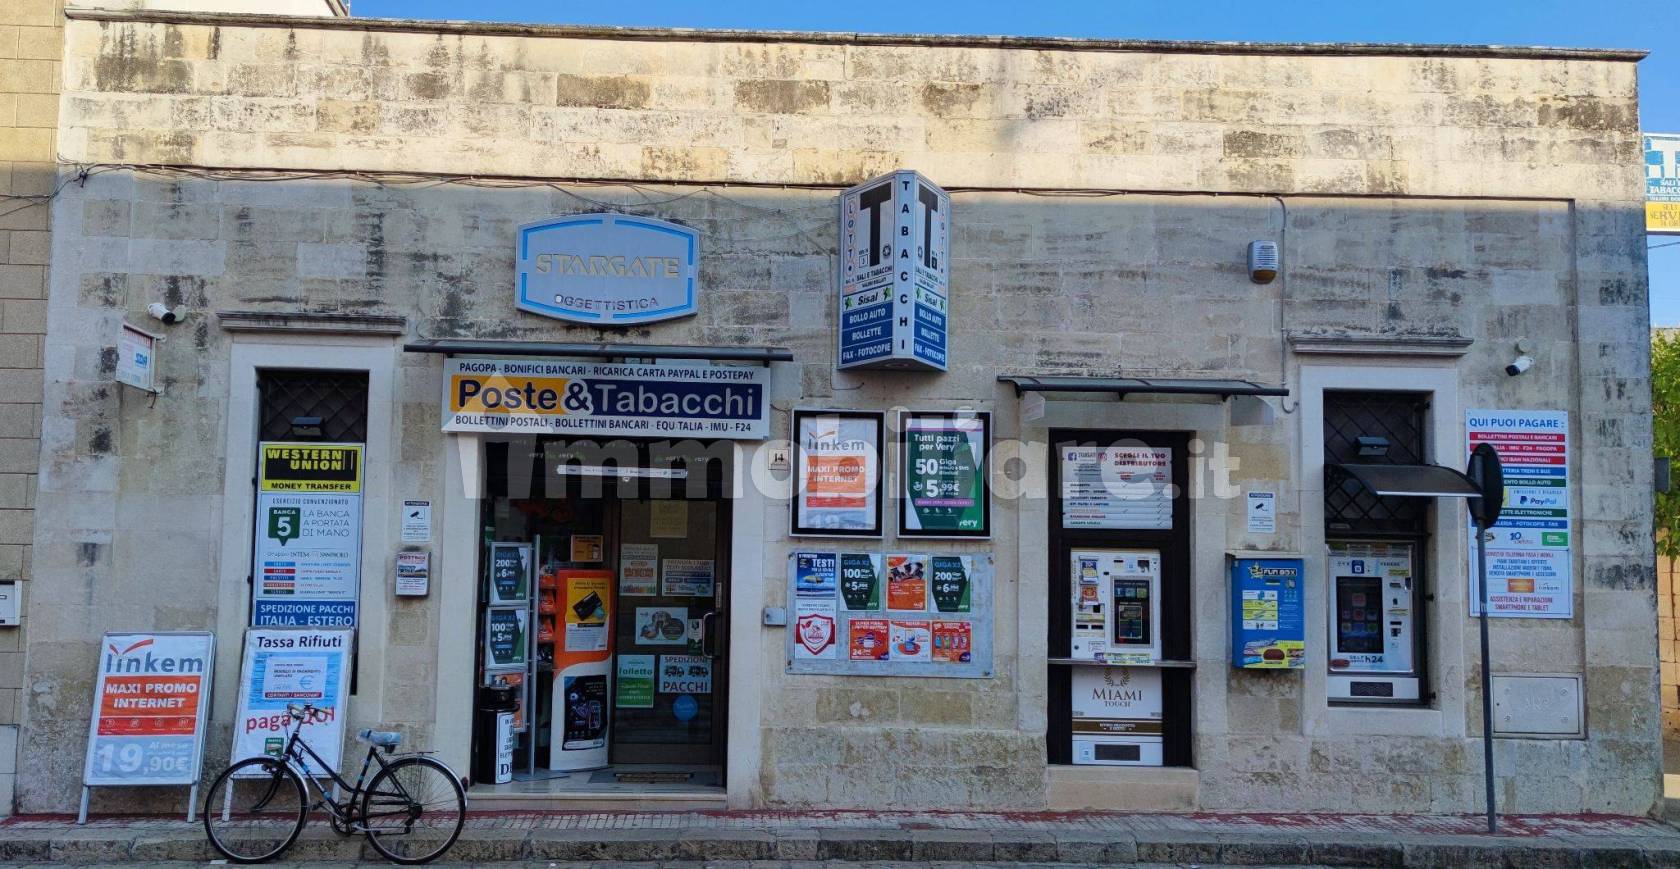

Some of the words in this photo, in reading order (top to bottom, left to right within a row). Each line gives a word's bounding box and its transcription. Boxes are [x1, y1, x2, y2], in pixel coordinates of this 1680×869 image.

[535, 254, 680, 279] STARGATE
[900, 181, 910, 350] TABACCHI
[554, 294, 660, 312] OGGETTISTICA
[858, 292, 878, 306] Sisal
[870, 308, 886, 319] AUTO
[843, 350, 854, 360] FAX
[858, 342, 891, 357] FOTOCOPIE
[459, 362, 497, 373] PAGOPA
[504, 364, 545, 374] BONIFICI
[546, 364, 586, 376] BANCARI
[593, 366, 634, 377] RICARICA
[636, 368, 666, 378] CARTA
[668, 369, 700, 379] PAYPAL
[703, 370, 708, 379] E
[710, 370, 754, 380] POSTEPAY
[594, 384, 754, 416] Tabacchi
[455, 415, 509, 426] BOLLETTINI
[510, 416, 548, 427] POSTALI
[555, 418, 607, 429] BOLLETTINI
[608, 419, 650, 430] BANCARI
[710, 422, 728, 432] IMU
[735, 423, 752, 433] F24
[1470, 418, 1488, 428] QUI
[1491, 418, 1516, 428] PUOI
[1518, 420, 1558, 428] PAGARE
[808, 437, 864, 450] linkem
[914, 434, 934, 442] Tutti
[936, 434, 960, 444] pazzi
[920, 444, 934, 452] per
[936, 443, 954, 452] Very
[267, 449, 342, 460] WESTERN
[290, 460, 342, 470] UNION
[916, 458, 938, 475] 50
[271, 482, 302, 490] MONEY
[1530, 496, 1557, 505] PayPal
[303, 510, 315, 518] LA
[316, 510, 350, 518] BANCA
[276, 516, 292, 536] 5
[302, 528, 313, 537] DI
[316, 528, 350, 538] MANO
[812, 559, 834, 567] TESTI
[844, 569, 860, 578] 100
[935, 572, 952, 580] 200
[260, 604, 316, 614] SPEDIZIONE
[318, 605, 354, 614] PACCHI
[260, 615, 297, 626] ITALIA
[308, 616, 353, 626] ESTERO
[257, 636, 294, 648] Tassa
[299, 635, 342, 648] Rifiuti
[106, 651, 203, 673] linkem
[1365, 655, 1384, 663] h24
[105, 684, 141, 694] MAXI
[145, 683, 197, 694] PROMO
[663, 682, 707, 692] PACCHI
[1092, 688, 1142, 701] MIAMI
[113, 698, 186, 709] INTERNET
